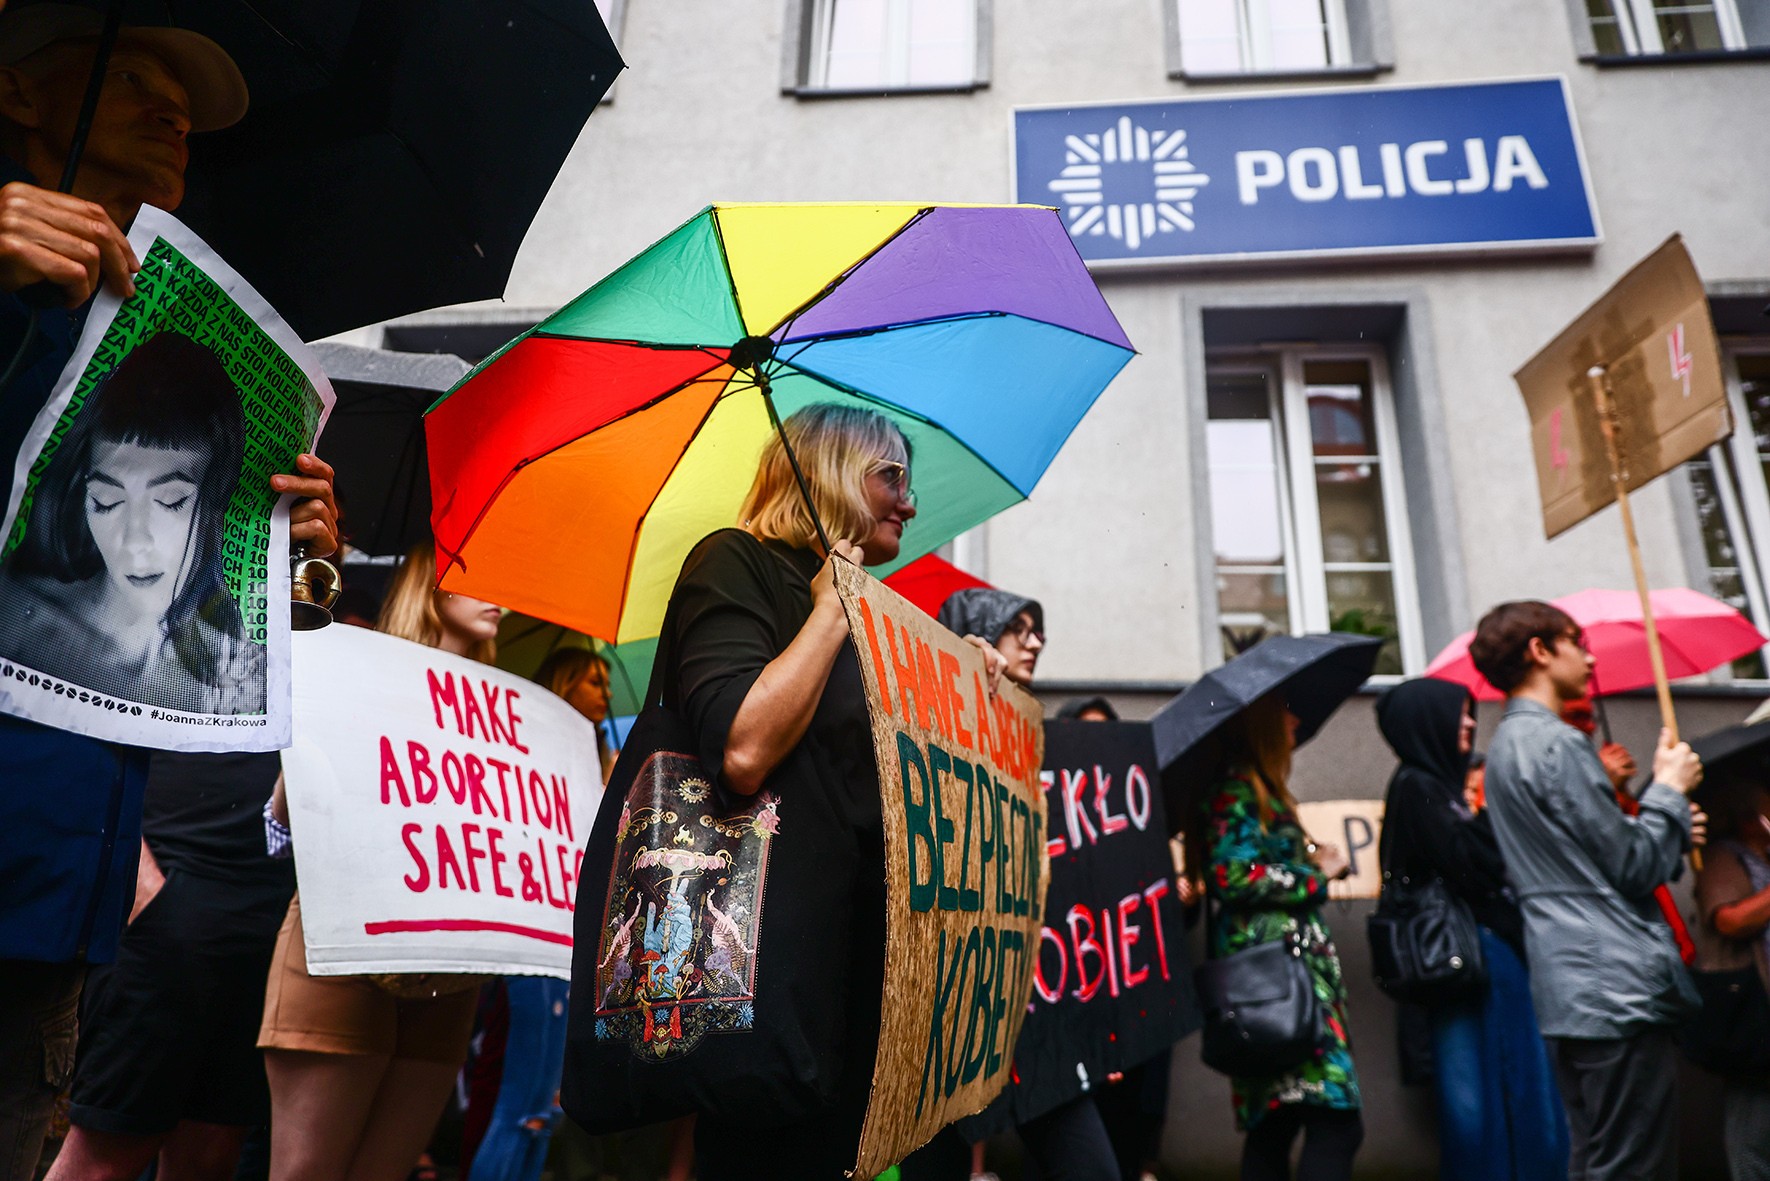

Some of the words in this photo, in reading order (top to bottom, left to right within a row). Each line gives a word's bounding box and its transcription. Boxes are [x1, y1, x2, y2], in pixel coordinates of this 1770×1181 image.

[1235, 135, 1550, 205] POLICJA
[148, 240, 173, 263] ZA
[175, 258, 220, 309] KAŻDĄ
[217, 298, 231, 315] Z
[226, 306, 252, 336] NAS
[250, 331, 277, 360] STOI
[112, 309, 137, 334] ZA
[140, 257, 164, 282] ZA
[165, 274, 210, 325] KAŻDĄ
[206, 313, 221, 331] Z
[216, 322, 242, 351] NAS
[240, 345, 267, 375] STOI
[103, 326, 128, 352] ZA
[93, 343, 118, 370] ZA
[134, 274, 155, 300] ZA
[156, 291, 199, 338] KAŻDĄ
[195, 329, 210, 344] Z
[207, 339, 233, 367] NAS
[229, 361, 258, 390] STOI
[254, 383, 307, 439] KOLEJNYCH
[244, 397, 302, 454] KOLEJNYCH
[257, 503, 274, 521] 10
[254, 519, 271, 536] 10
[252, 534, 270, 552] 10
[248, 551, 268, 567] 10
[247, 567, 269, 580] 10
[247, 581, 269, 595] 10
[246, 596, 269, 610] 10
[246, 611, 269, 626] 10
[246, 627, 269, 641] 10
[859, 596, 894, 718] I
[882, 612, 975, 751] HAVE
[150, 709, 268, 728] #JoannaZKrakowa
[426, 668, 531, 756] MAKE
[379, 735, 575, 843] ABORTION
[1039, 763, 1152, 859] KŁO
